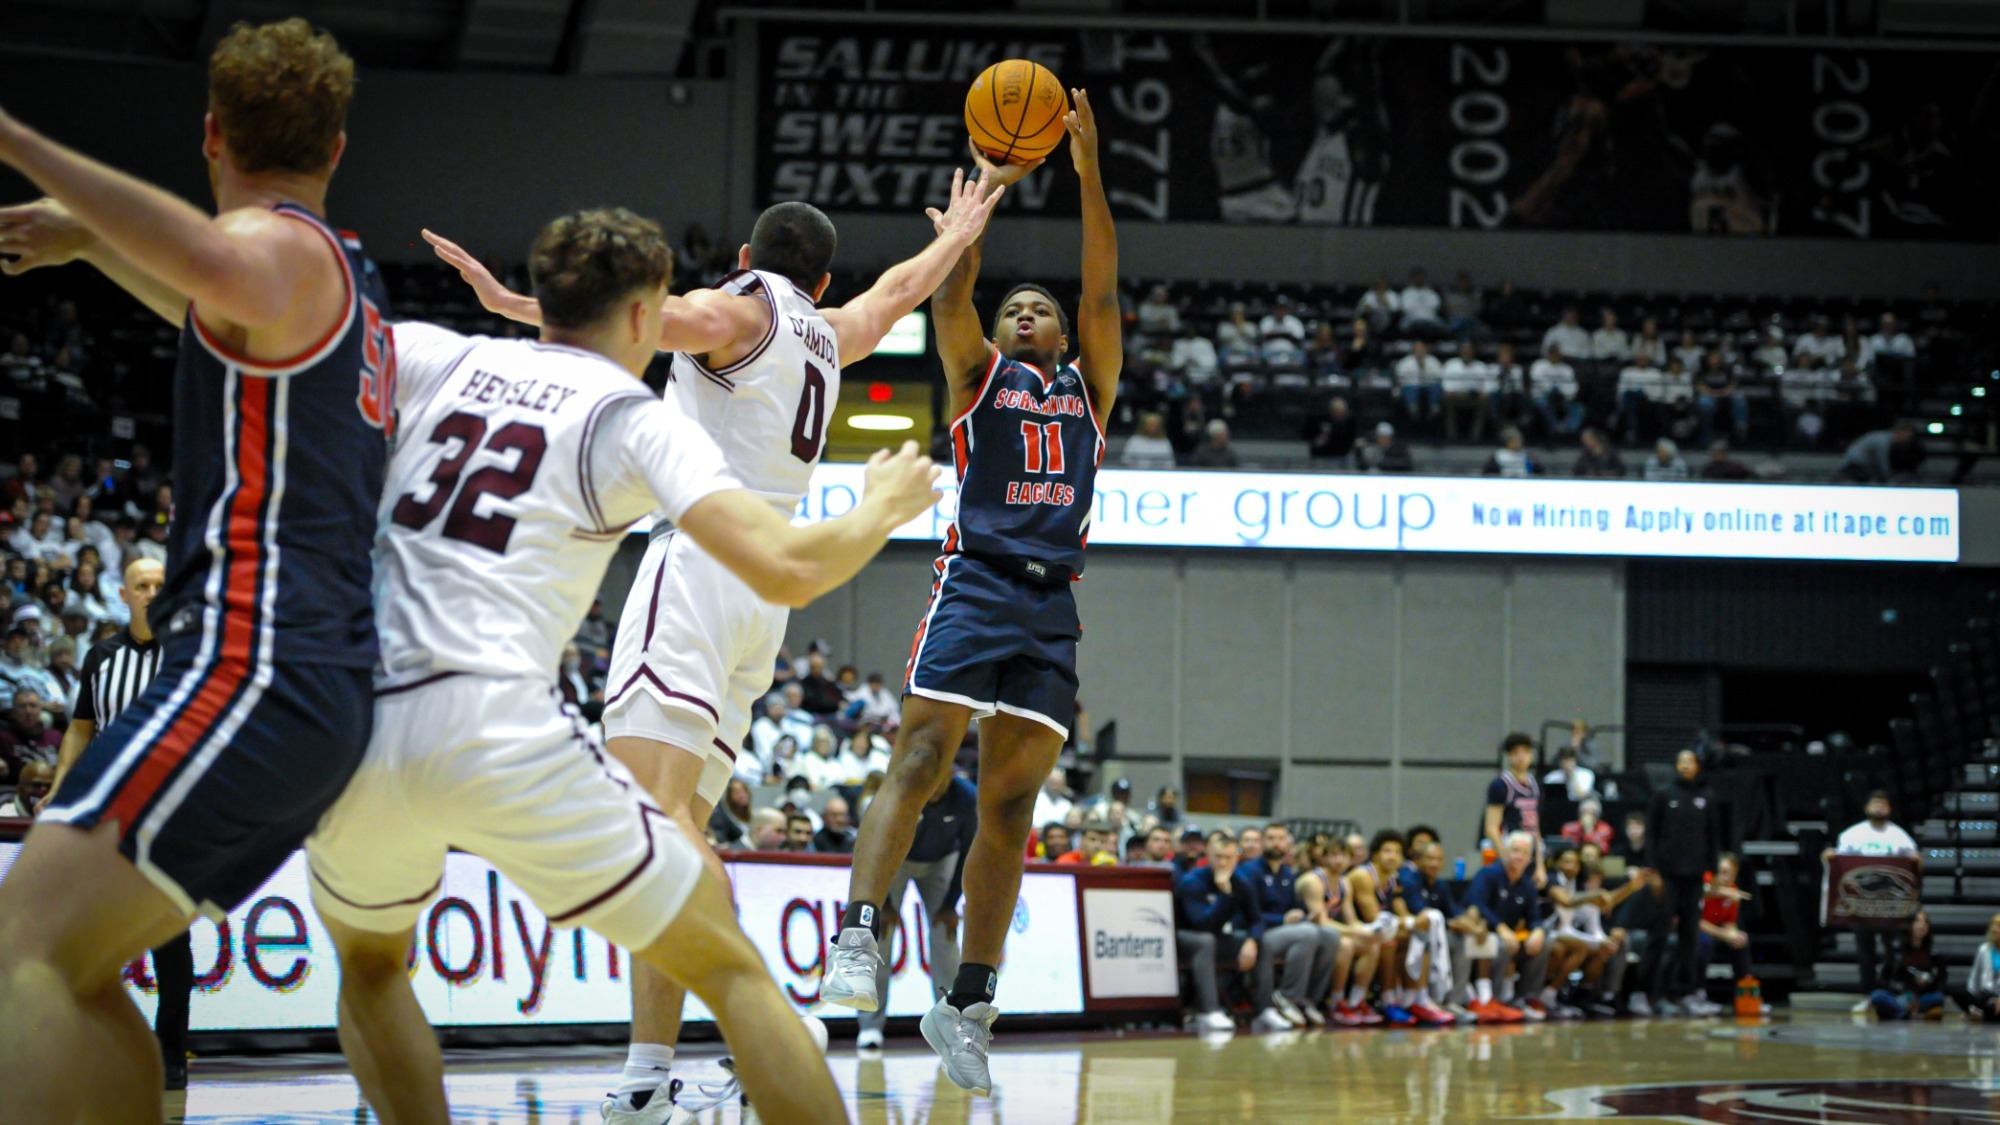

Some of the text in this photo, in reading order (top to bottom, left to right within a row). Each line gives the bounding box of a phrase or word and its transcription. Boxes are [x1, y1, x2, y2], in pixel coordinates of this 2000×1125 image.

[770, 111, 972, 157] SWEE
[1107, 34, 1172, 220] 1977
[1448, 44, 1510, 229] 2002
[1811, 53, 1871, 238] 2007
[770, 160, 1056, 209] SIXTEN
[791, 359, 826, 464] 0
[1020, 419, 1066, 475] 11
[391, 410, 548, 556] 32
[1006, 481, 1075, 506] EAGLES
[1234, 488, 1436, 551] group
[1472, 502, 1523, 526] Now
[1532, 503, 1609, 532] Hiring
[1624, 504, 1695, 534] Apply
[1703, 507, 1783, 533] online
[1793, 511, 1815, 533] at
[1095, 930, 1164, 958] Banterra
